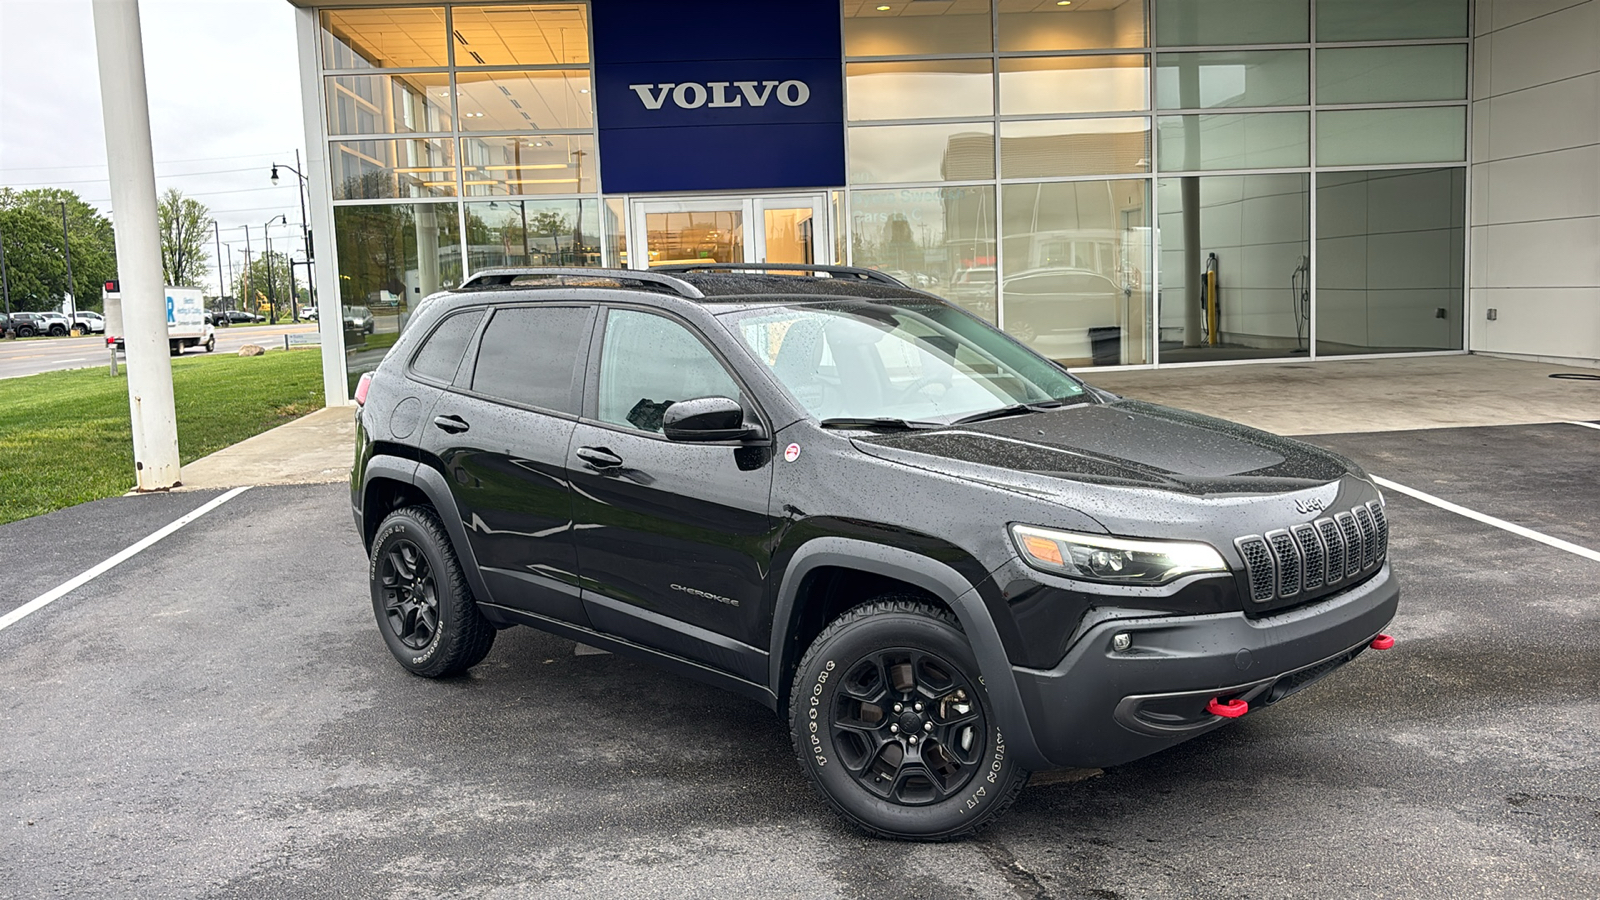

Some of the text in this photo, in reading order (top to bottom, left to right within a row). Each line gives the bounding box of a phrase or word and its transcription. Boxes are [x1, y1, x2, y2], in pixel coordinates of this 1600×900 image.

[629, 80, 810, 110] VOLVO
[900, 188, 966, 203] Swedish
[852, 209, 888, 223] Cars
[1295, 496, 1325, 514] Jeep
[670, 583, 740, 607] CHEROKEE
[809, 660, 836, 767] Firestone
